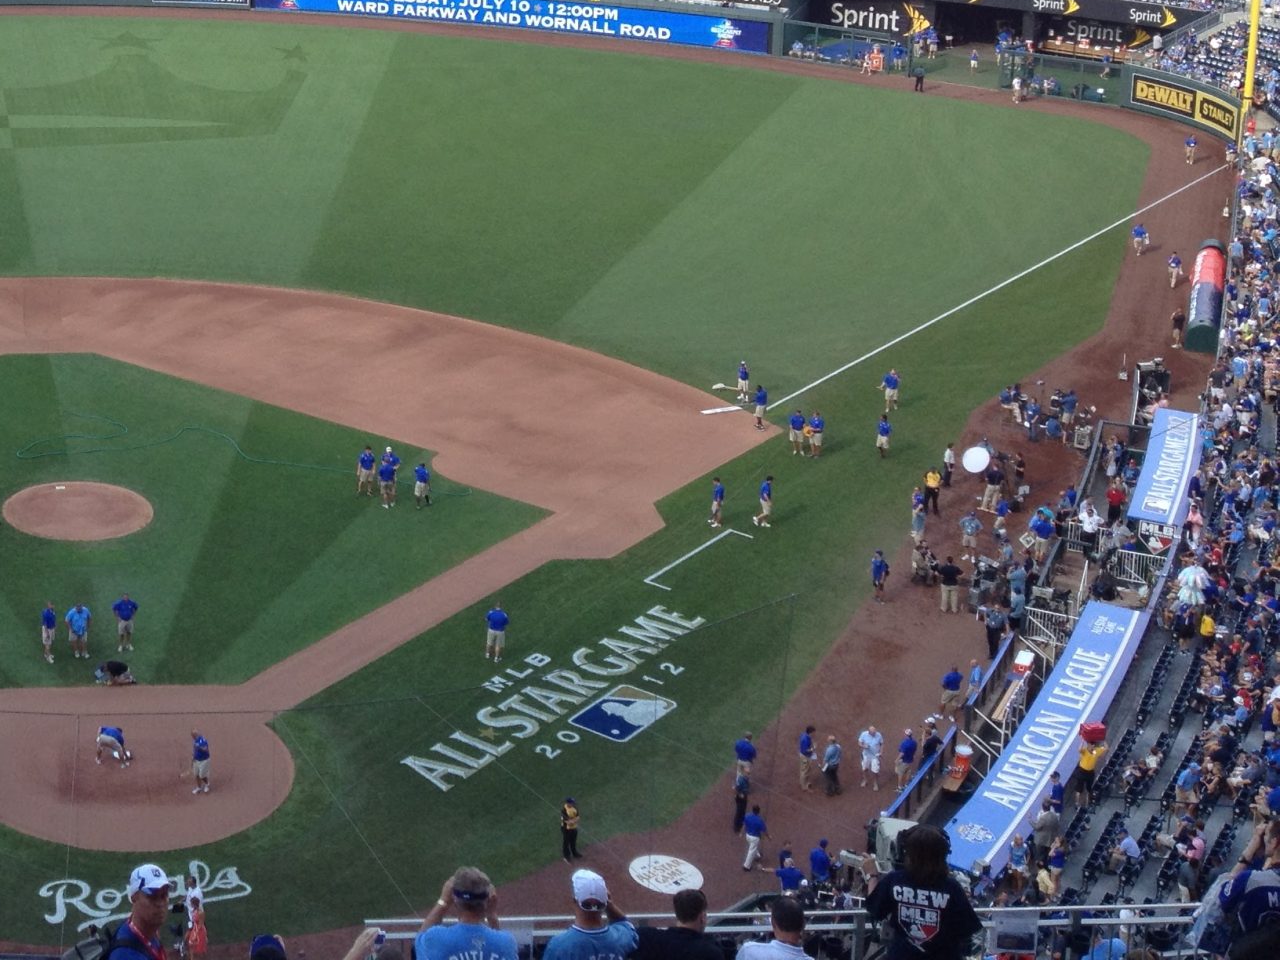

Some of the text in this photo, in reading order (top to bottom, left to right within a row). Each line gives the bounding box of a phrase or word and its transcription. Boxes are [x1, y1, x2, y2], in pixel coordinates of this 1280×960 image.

[337, 0, 671, 40] WARD PARKWAY AND WORNALL ROAD
[509, 0, 530, 12] 10
[546, 3, 618, 21] 12:00PM
[830, 2, 899, 33] Sprint
[1129, 7, 1162, 25] Sprint
[1067, 18, 1123, 45] Sprint
[1202, 102, 1234, 127] STANLEY
[1141, 521, 1174, 535] MLB
[572, 604, 707, 676] GAME
[481, 652, 552, 694] MLB
[983, 711, 1077, 811] AMERICAN
[1047, 647, 1112, 724] LEAGUE
[893, 885, 951, 909] CREW
[900, 906, 938, 922] MLB
